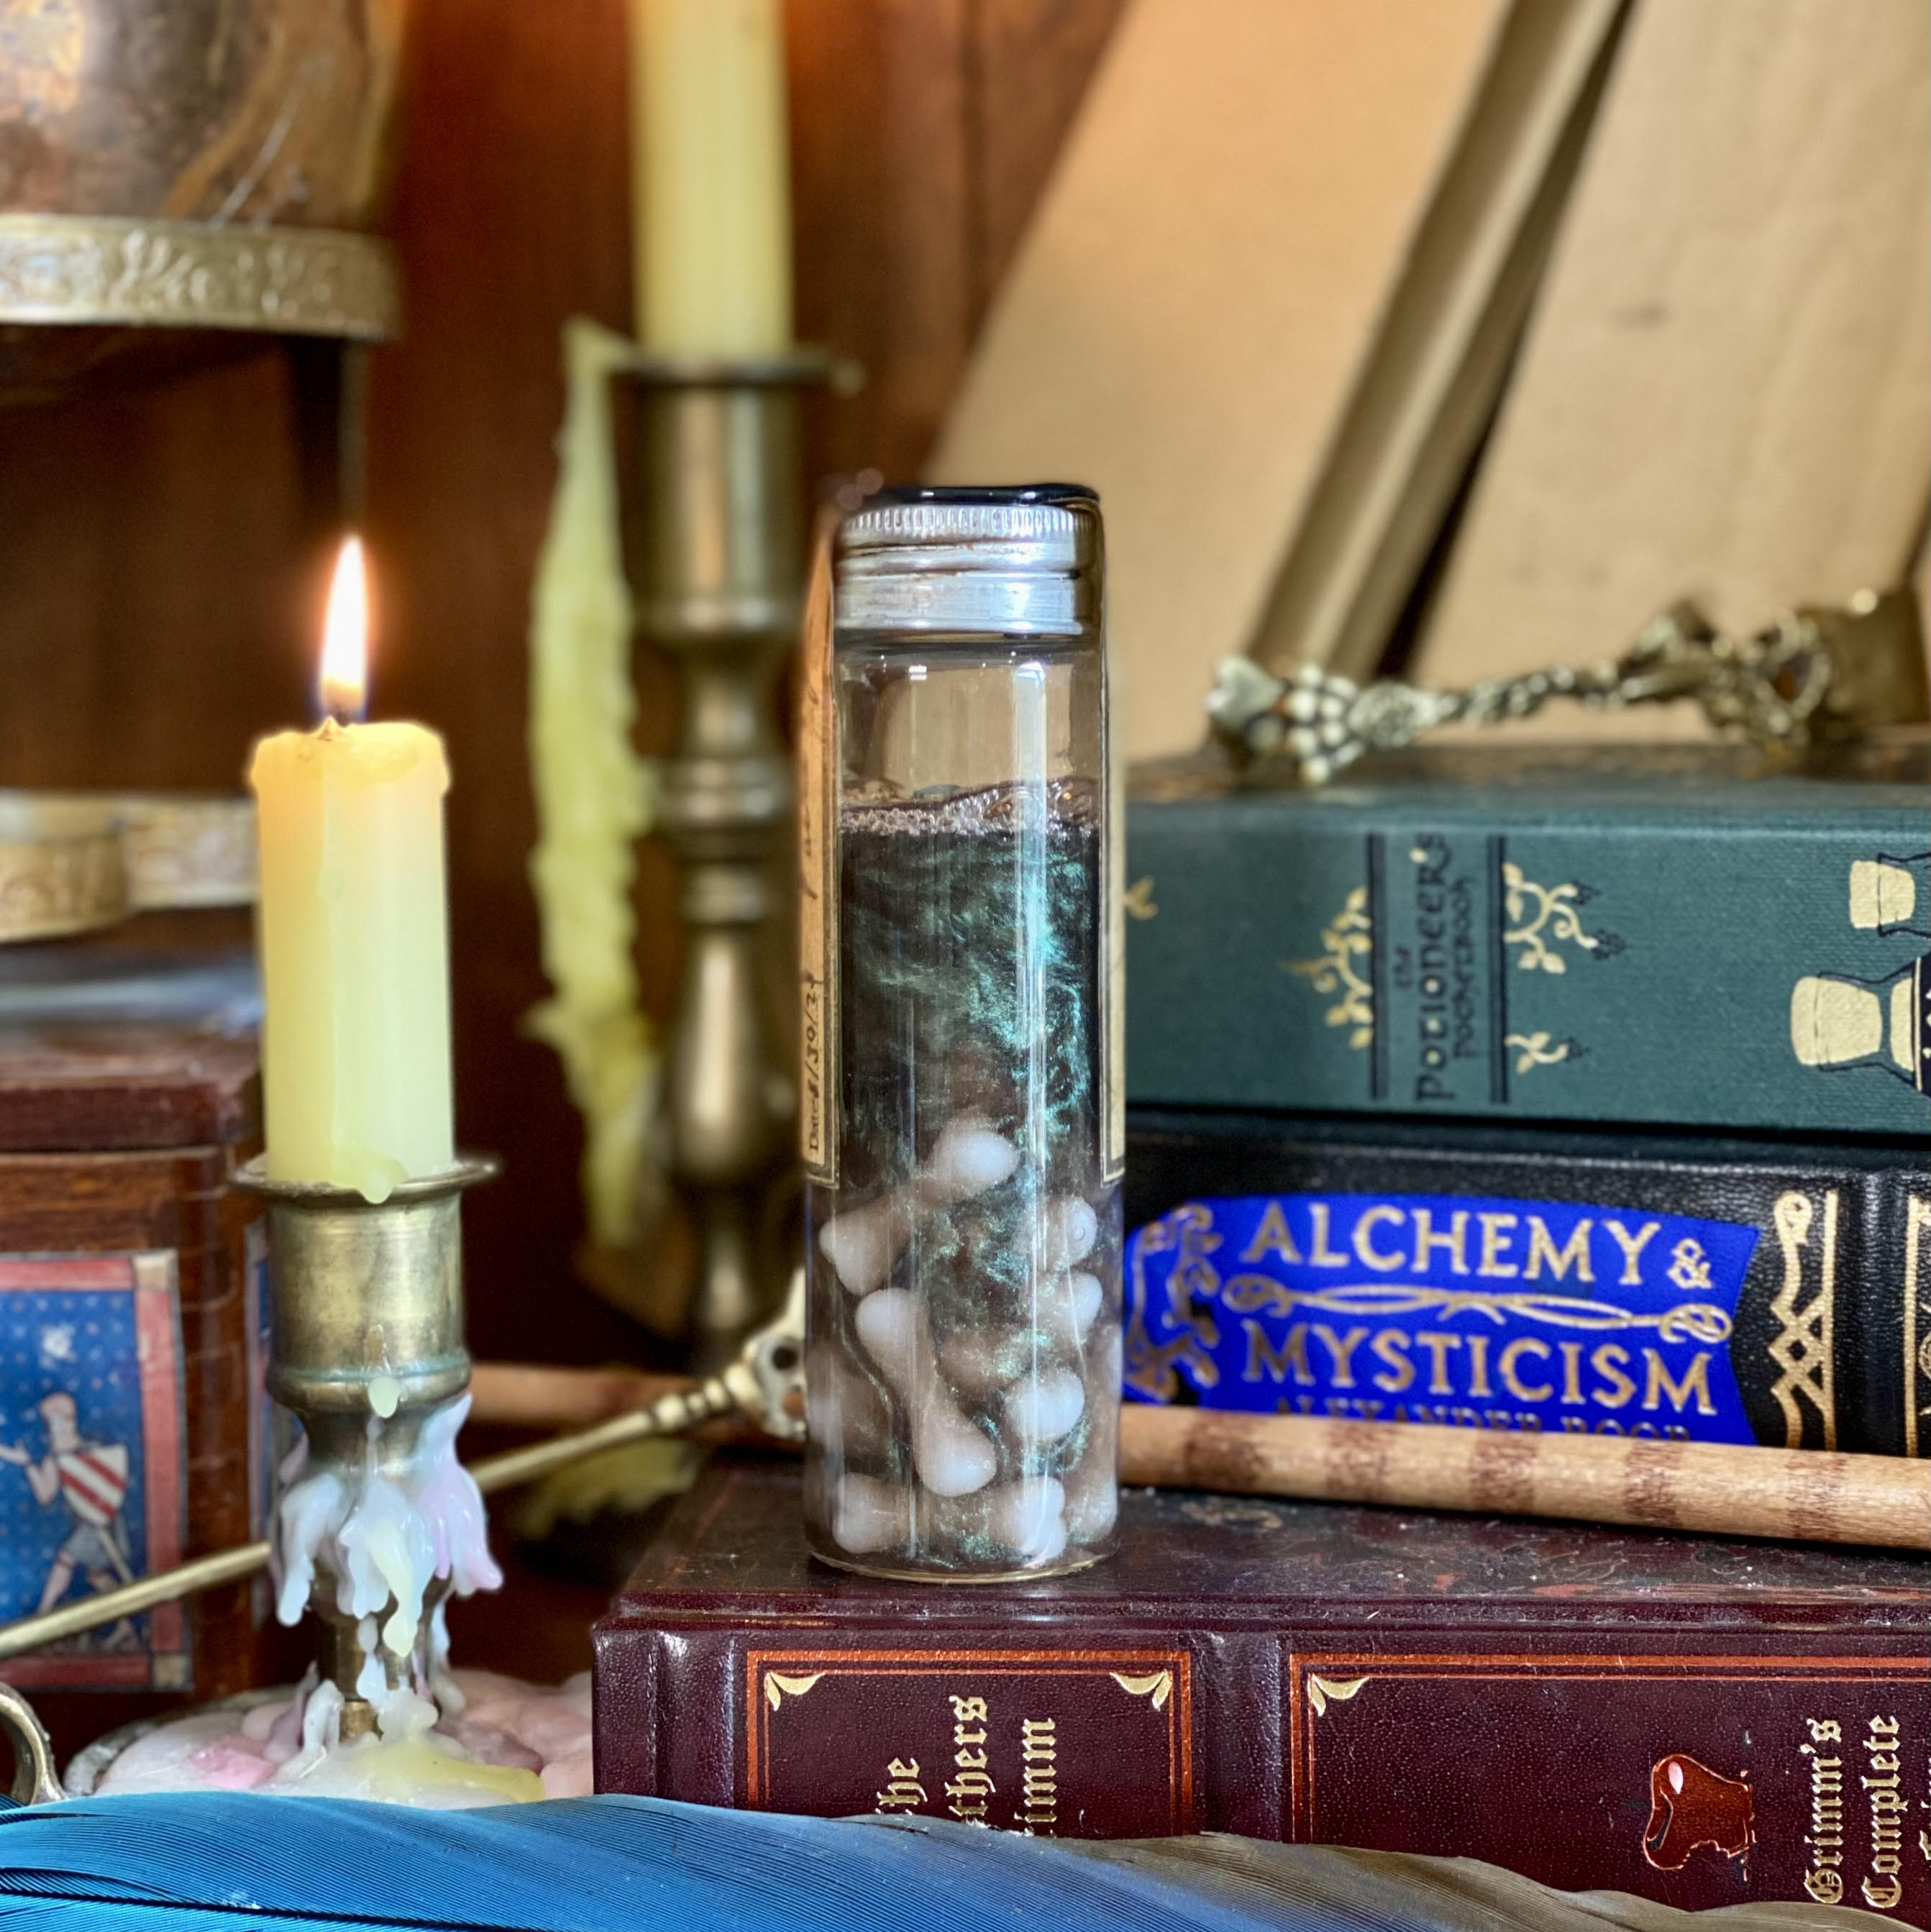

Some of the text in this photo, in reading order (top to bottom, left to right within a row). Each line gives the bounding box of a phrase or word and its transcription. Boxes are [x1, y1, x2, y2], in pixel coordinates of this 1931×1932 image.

[1240, 1200, 1715, 1289] ALCHEMY &
[1241, 1318, 1718, 1416] MYSTICISM
[875, 1756, 928, 1815] he
[944, 1695, 995, 1817] thers
[1799, 1717, 1843, 1904] Grimm's
[1861, 1715, 1909, 1908] Complete
